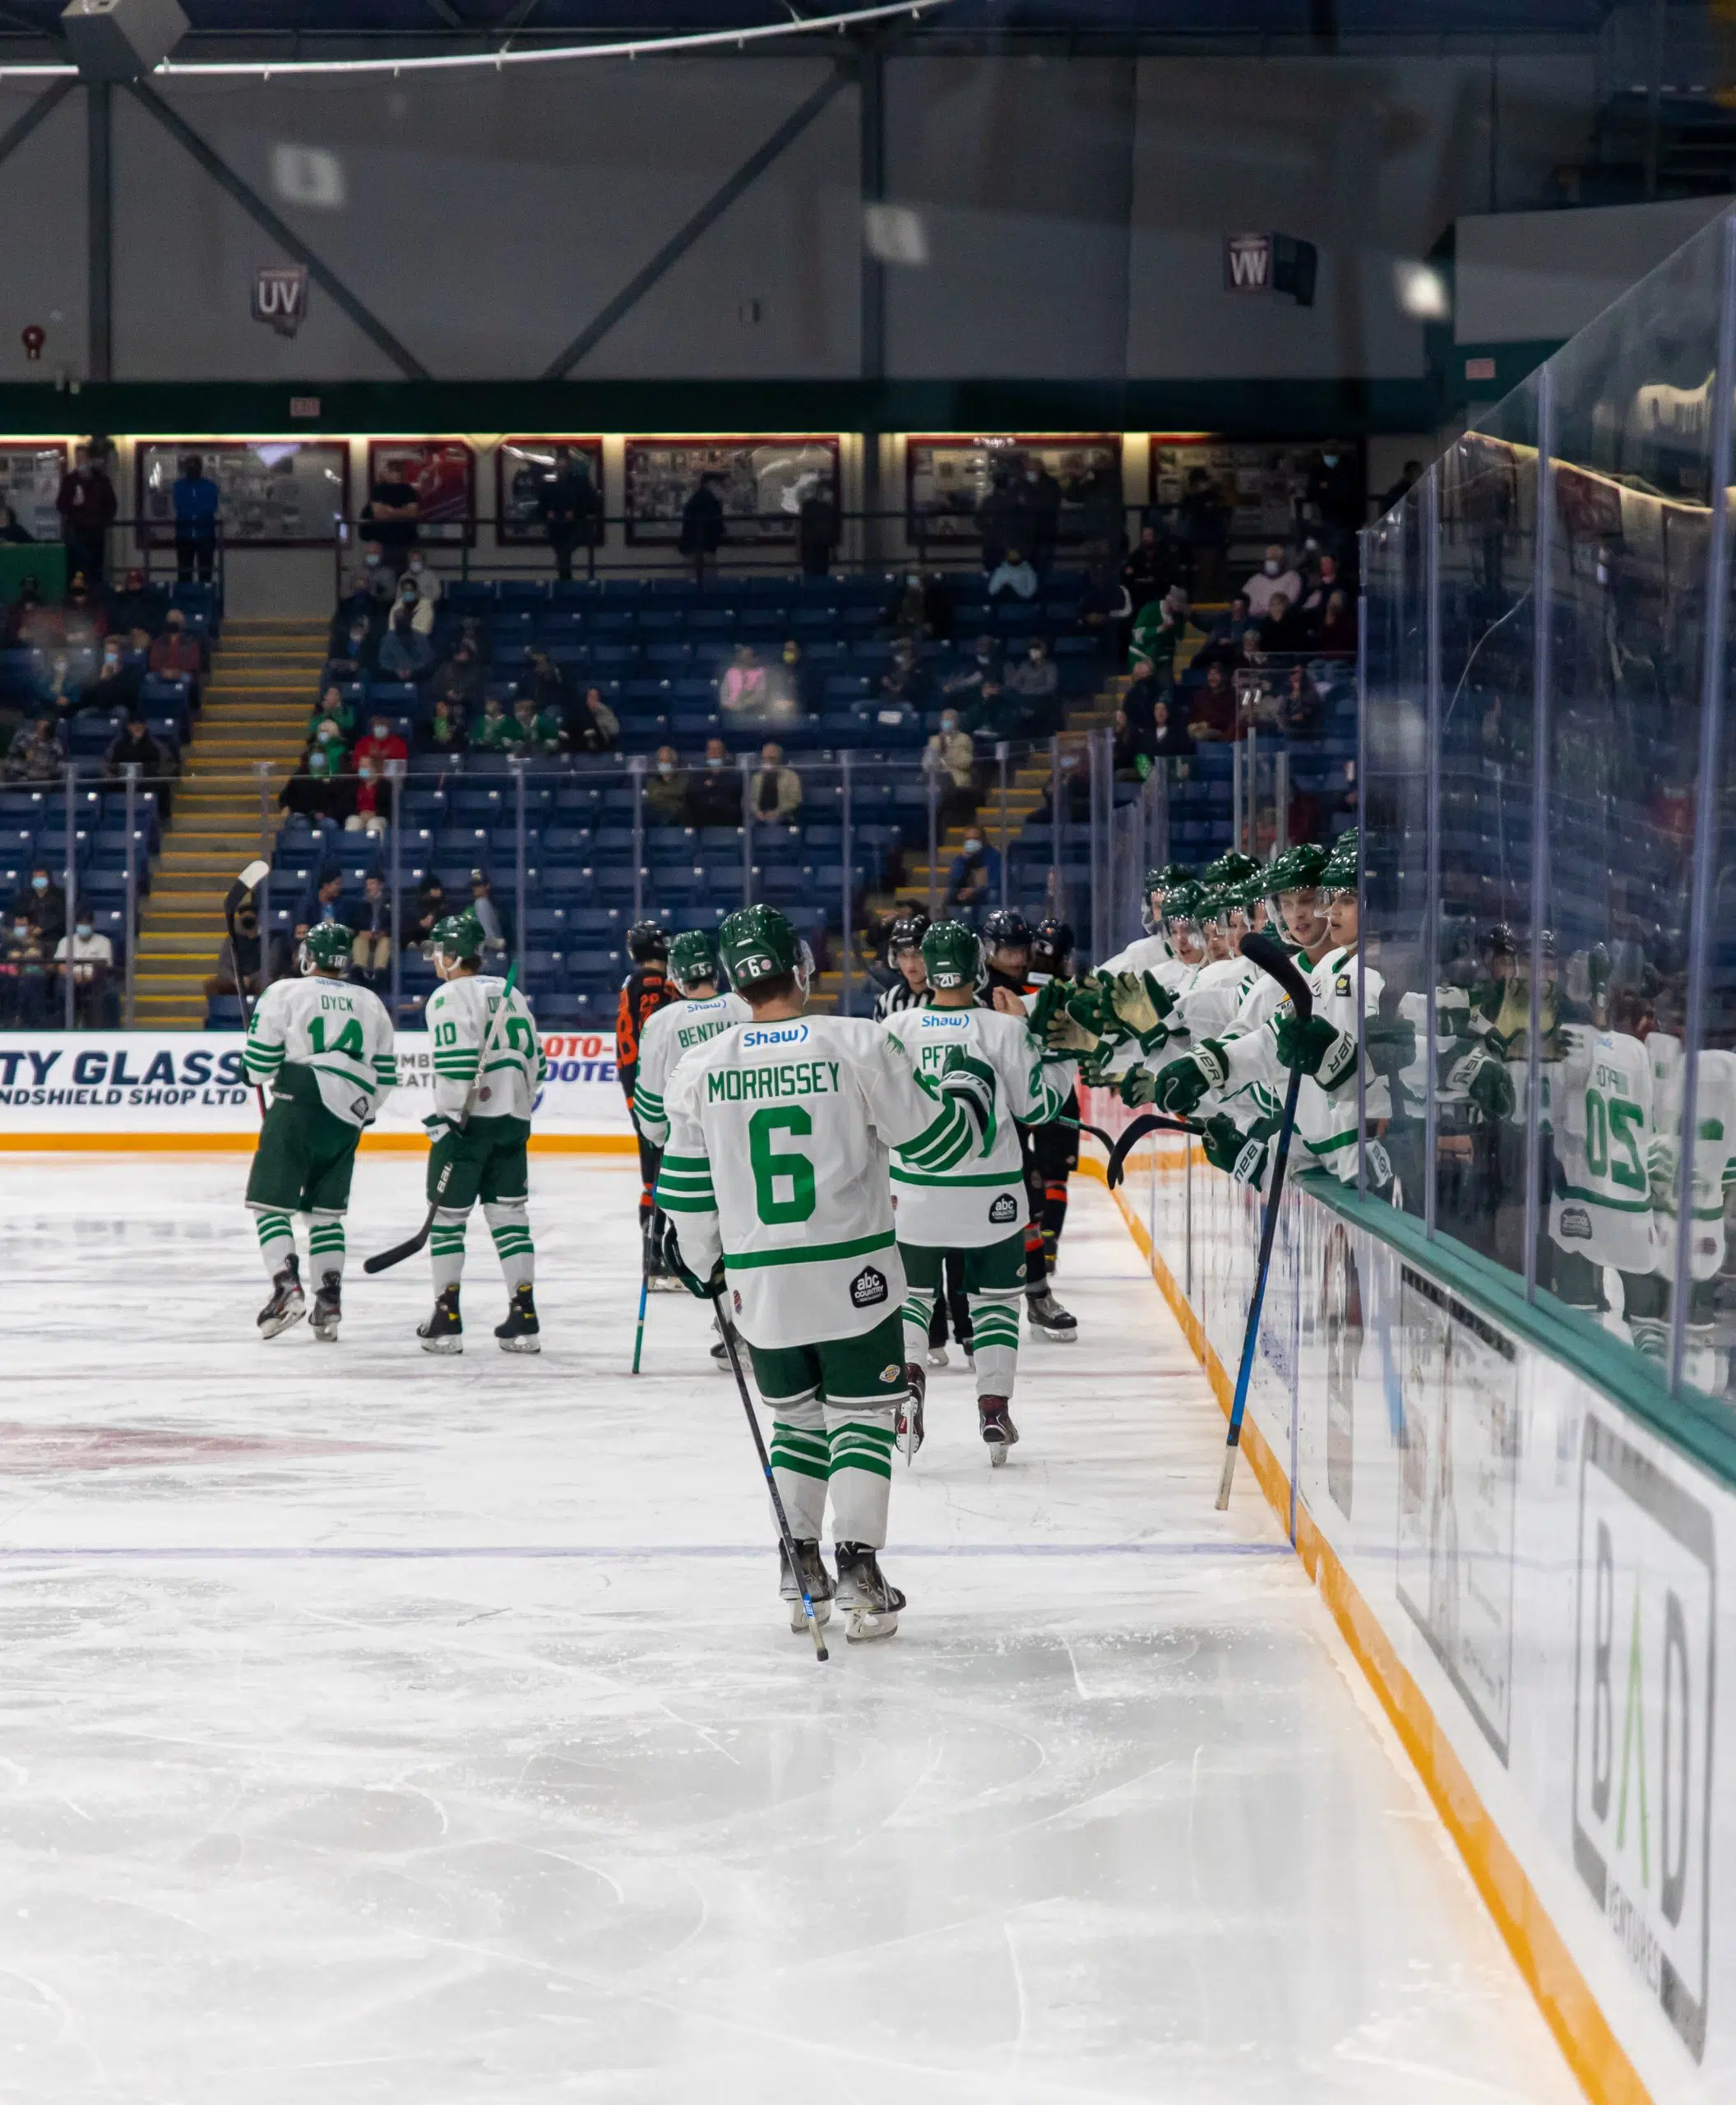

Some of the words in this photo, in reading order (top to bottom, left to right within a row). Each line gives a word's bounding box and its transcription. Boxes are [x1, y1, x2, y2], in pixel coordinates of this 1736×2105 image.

[259, 280, 299, 312] UV
[747, 958, 761, 978] 6
[938, 974, 955, 987] 20
[321, 994, 354, 1012] DYCK
[307, 1016, 363, 1061] 14
[434, 1021, 456, 1048] 10
[743, 1028, 799, 1047] Shaw
[0, 1049, 64, 1085] TY
[72, 1049, 244, 1086] GLASS
[707, 1062, 840, 1103] MORRISSEY
[128, 1088, 197, 1105] SHOP
[748, 1104, 817, 1225] 6
[995, 1197, 1014, 1211] abc
[854, 1284, 884, 1298] COUNTRY
[857, 1272, 880, 1291] abc
